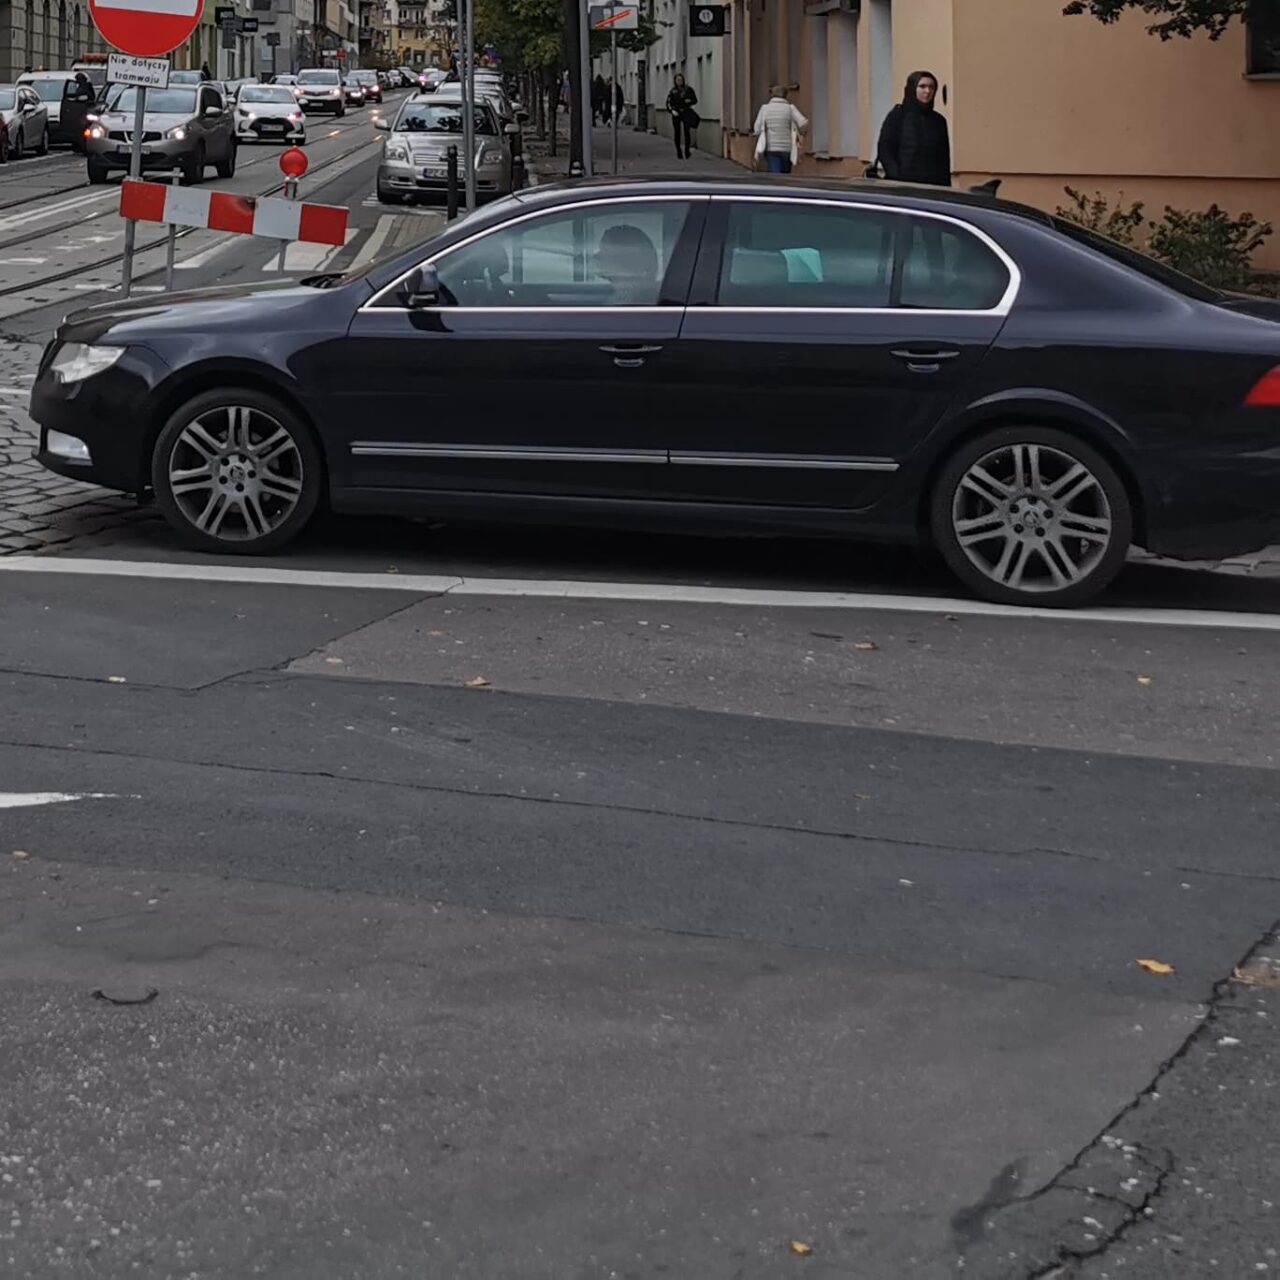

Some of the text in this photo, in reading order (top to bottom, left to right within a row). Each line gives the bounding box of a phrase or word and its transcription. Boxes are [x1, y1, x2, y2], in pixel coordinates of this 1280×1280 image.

[110, 54, 167, 72] Nie dotyczy
[115, 71, 160, 84] tramwaju
